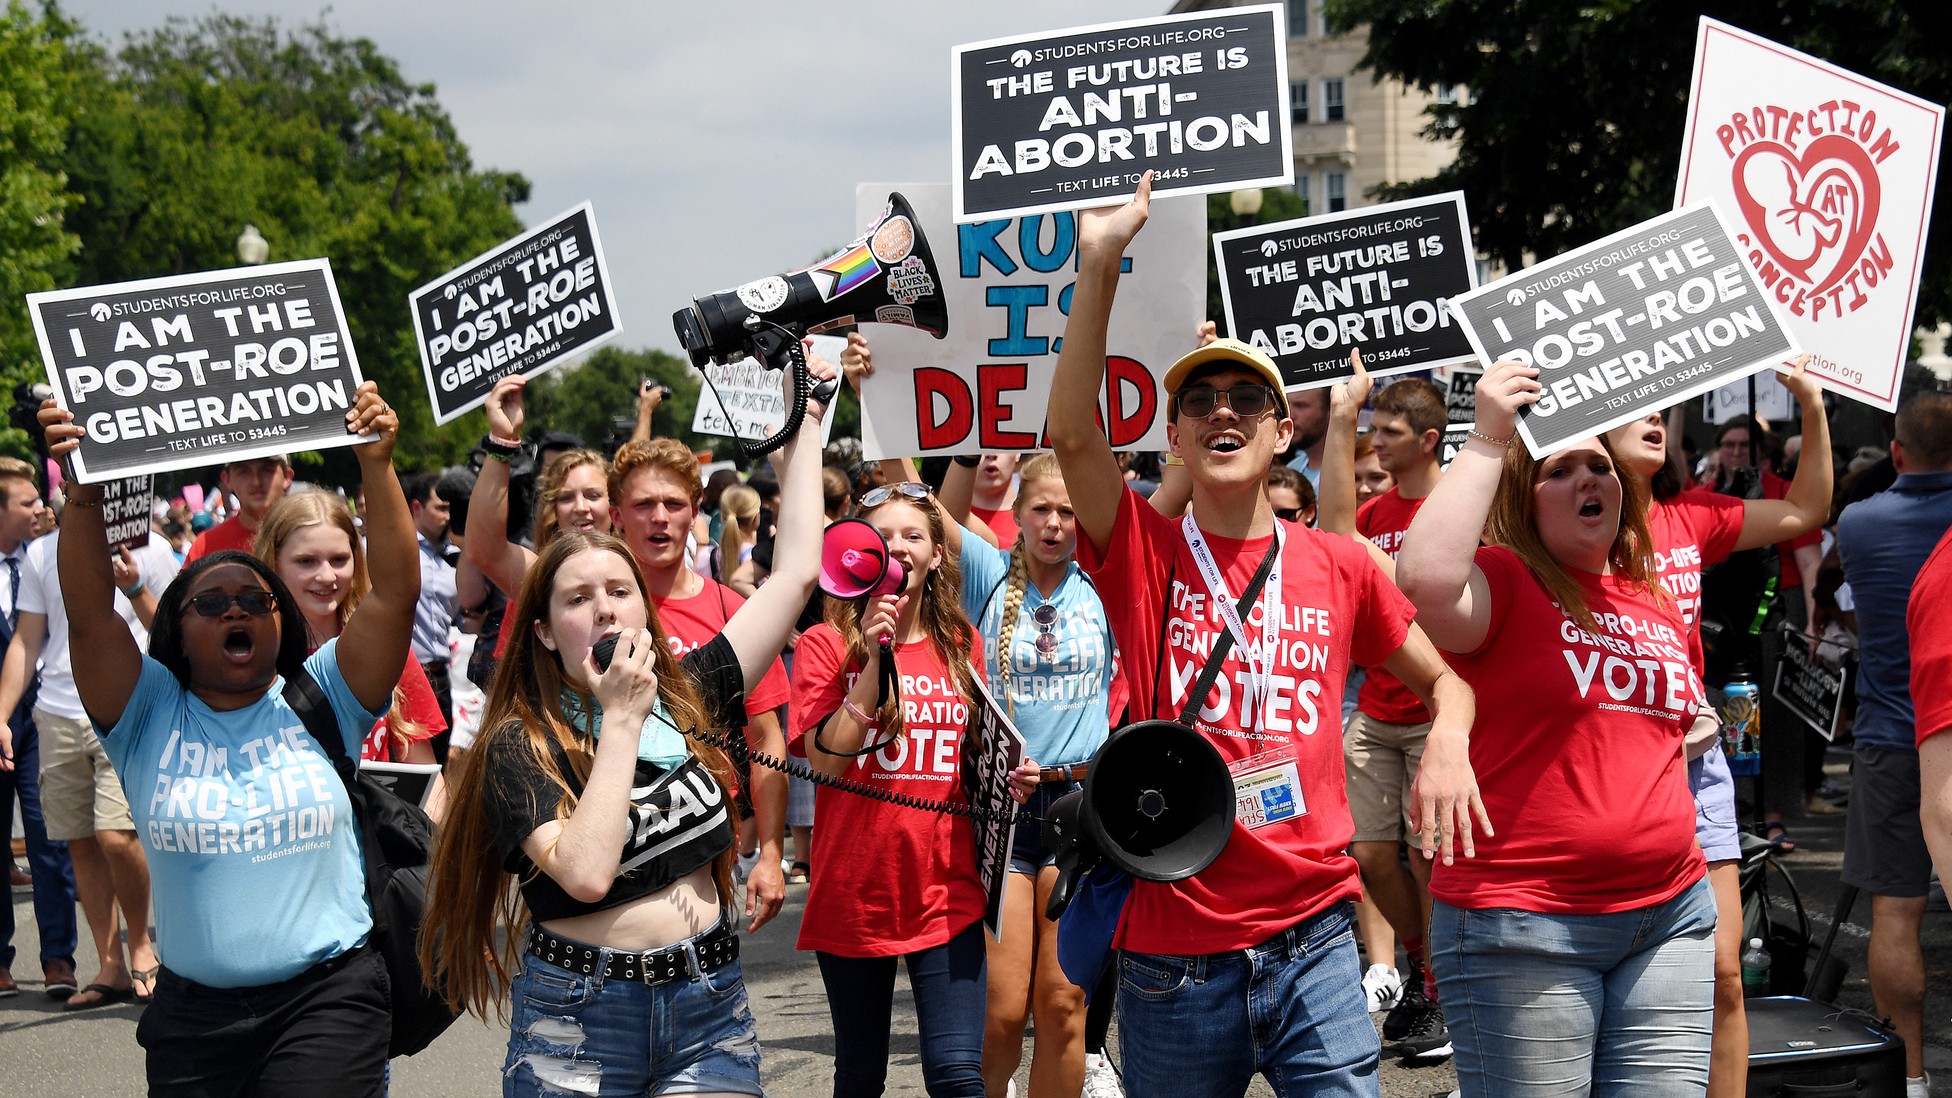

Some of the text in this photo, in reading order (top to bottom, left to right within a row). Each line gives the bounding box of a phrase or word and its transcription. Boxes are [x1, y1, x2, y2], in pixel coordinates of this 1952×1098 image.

[1035, 27, 1226, 62] STUDENTSFORLIFE.ORG
[987, 47, 1249, 100] THE FUTURE IS
[1038, 82, 1198, 132] ANTI-
[969, 110, 1271, 181] ABORTION
[1715, 99, 1900, 166] PROTECTION
[1056, 167, 1189, 193] TEXT LIFE TO 3445
[1822, 184, 1848, 215] AT
[957, 211, 1132, 278] RO
[1279, 216, 1423, 251] STUDENTSFORLIFE.ORG
[431, 235, 581, 331] I AM THE
[457, 229, 563, 292] STUDENTSFORLIFE.ORG
[893, 266, 923, 280] BLACK
[897, 276, 923, 288] LIVES
[1246, 235, 1444, 287] THE FUTURE IS
[1525, 229, 1681, 298] STUDENTSFORLIFE.ORG
[113, 283, 287, 316] STUDENTSFORLIFE.ORG
[429, 255, 595, 367] POST-ROE
[895, 285, 932, 300] MATTER
[1292, 270, 1409, 318] ANTI-
[1492, 237, 1716, 344] I AM THE
[69, 298, 316, 358] I AM THE
[440, 291, 601, 393] GENERATION
[65, 332, 340, 404] POST-ROE
[507, 360, 523, 374] LIFE
[524, 355, 535, 365] TO
[536, 341, 560, 360] 53445
[710, 362, 783, 390] EMBRYO
[1312, 360, 1336, 372] TEXT
[1362, 353, 1376, 364] TO
[1378, 347, 1411, 361] 53445
[718, 389, 784, 414] TEXTB
[913, 355, 1158, 451] DED
[1604, 360, 1713, 411] TEXT LIFE TO 53445
[85, 379, 349, 444] GENERATION
[703, 408, 743, 434] tells
[168, 425, 287, 452] TEXT LIFE TO 53445
[103, 492, 151, 523] ST-ROE
[126, 474, 148, 493] THE
[1198, 546, 1211, 568] STUDENTS
[1212, 576, 1220, 586] LIFE
[1653, 544, 1702, 572] O-LIFE
[1172, 580, 1206, 621] THE
[1224, 601, 1238, 624] STUDENTS
[1170, 649, 1322, 735] VOTES
[1563, 650, 1702, 715] VOTES
[159, 730, 180, 769] I
[178, 741, 234, 782] AM
[240, 725, 318, 777] THE
[857, 728, 965, 773] VOTE
[149, 763, 334, 820] PRO-LIFE
[623, 762, 722, 849] AAU
[981, 728, 1011, 894] ENERATION
[148, 803, 335, 854] GENERATION
[251, 840, 331, 864] studentsforlife.org
